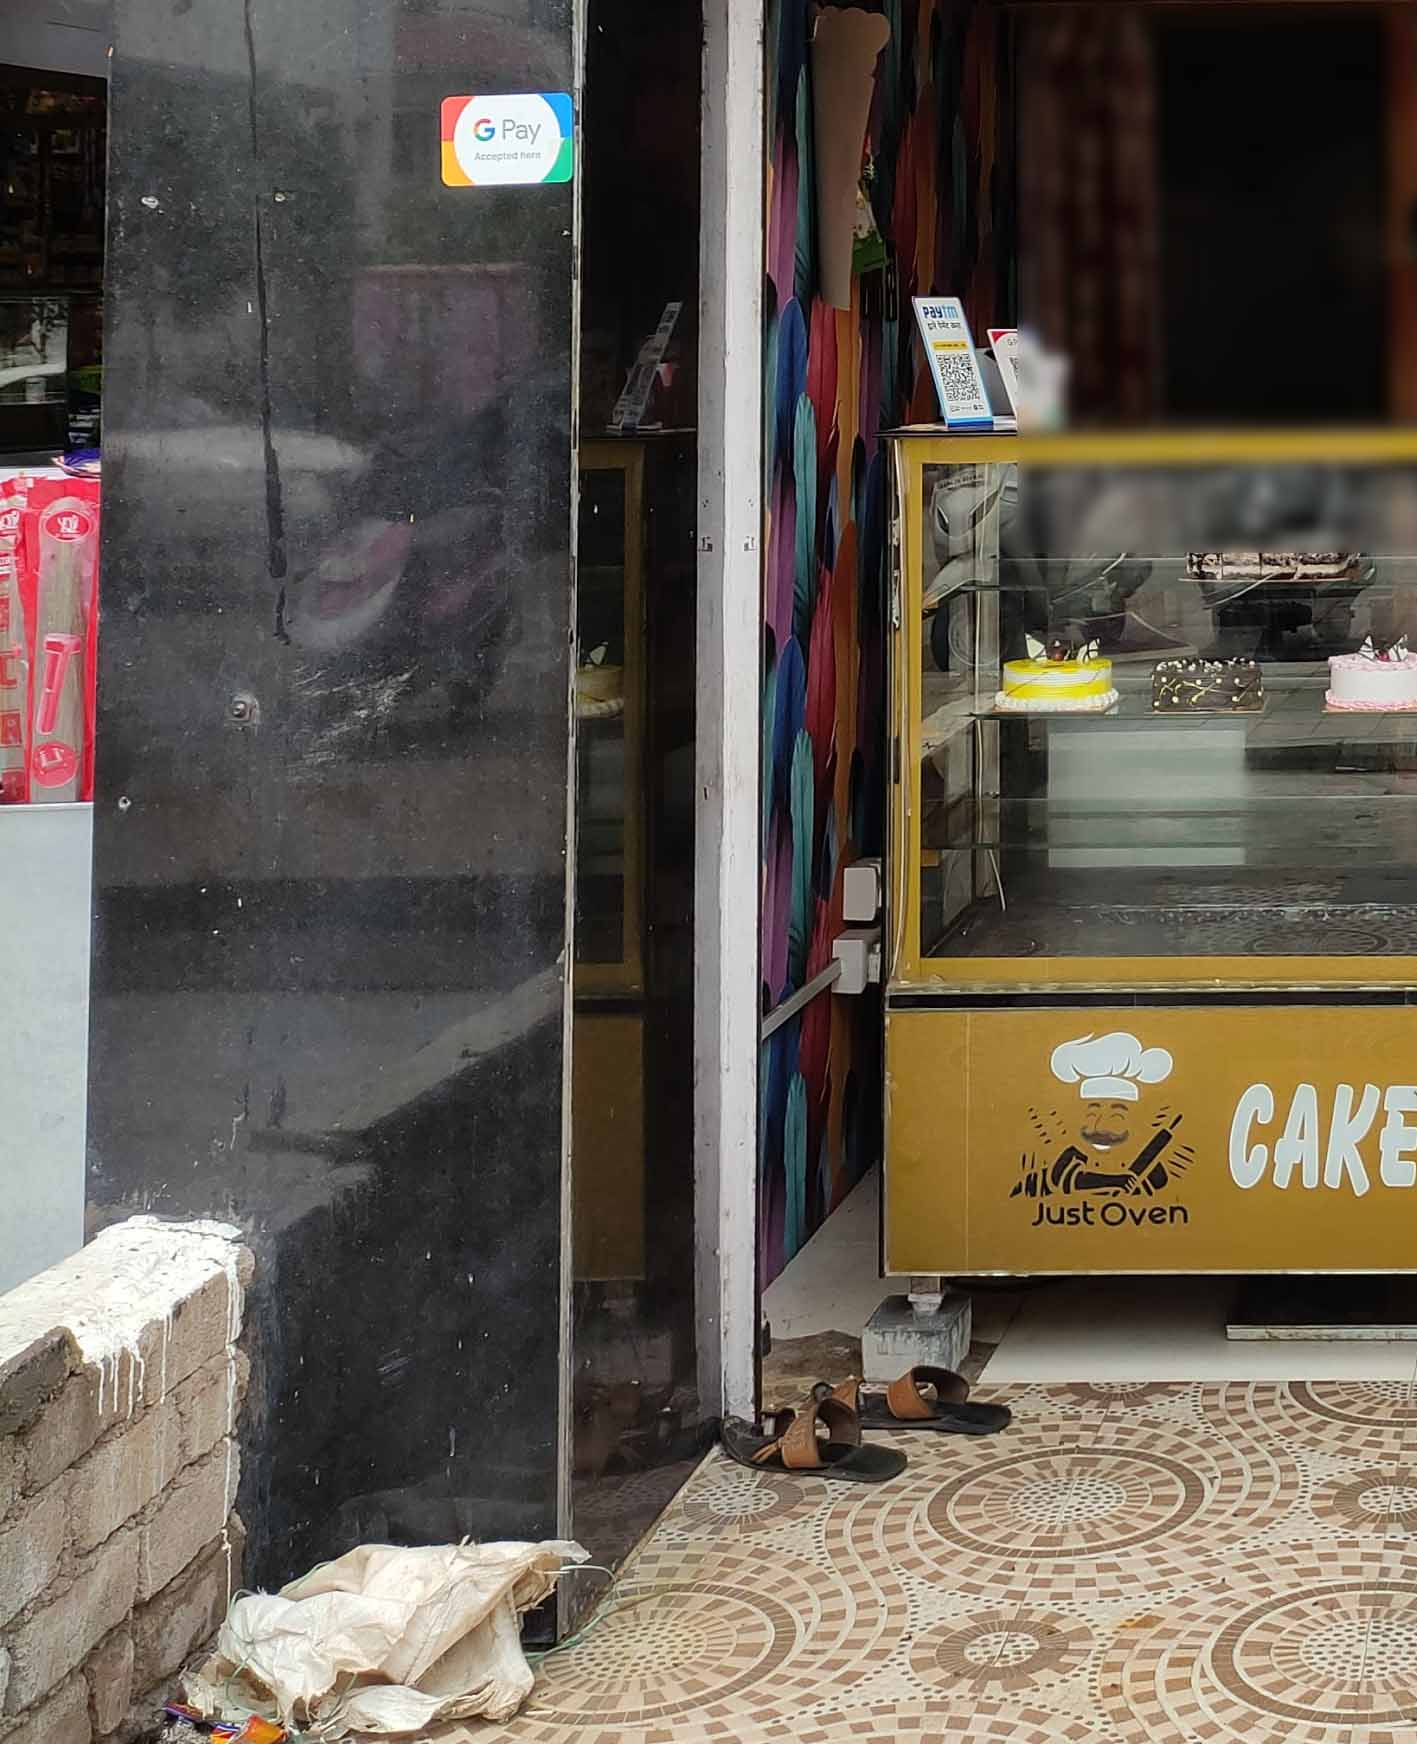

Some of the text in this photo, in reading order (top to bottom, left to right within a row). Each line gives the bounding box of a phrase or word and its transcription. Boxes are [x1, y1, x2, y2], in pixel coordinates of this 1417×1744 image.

[502, 119, 542, 145] Pay
[1032, 1200, 1188, 1226] Just Oven
